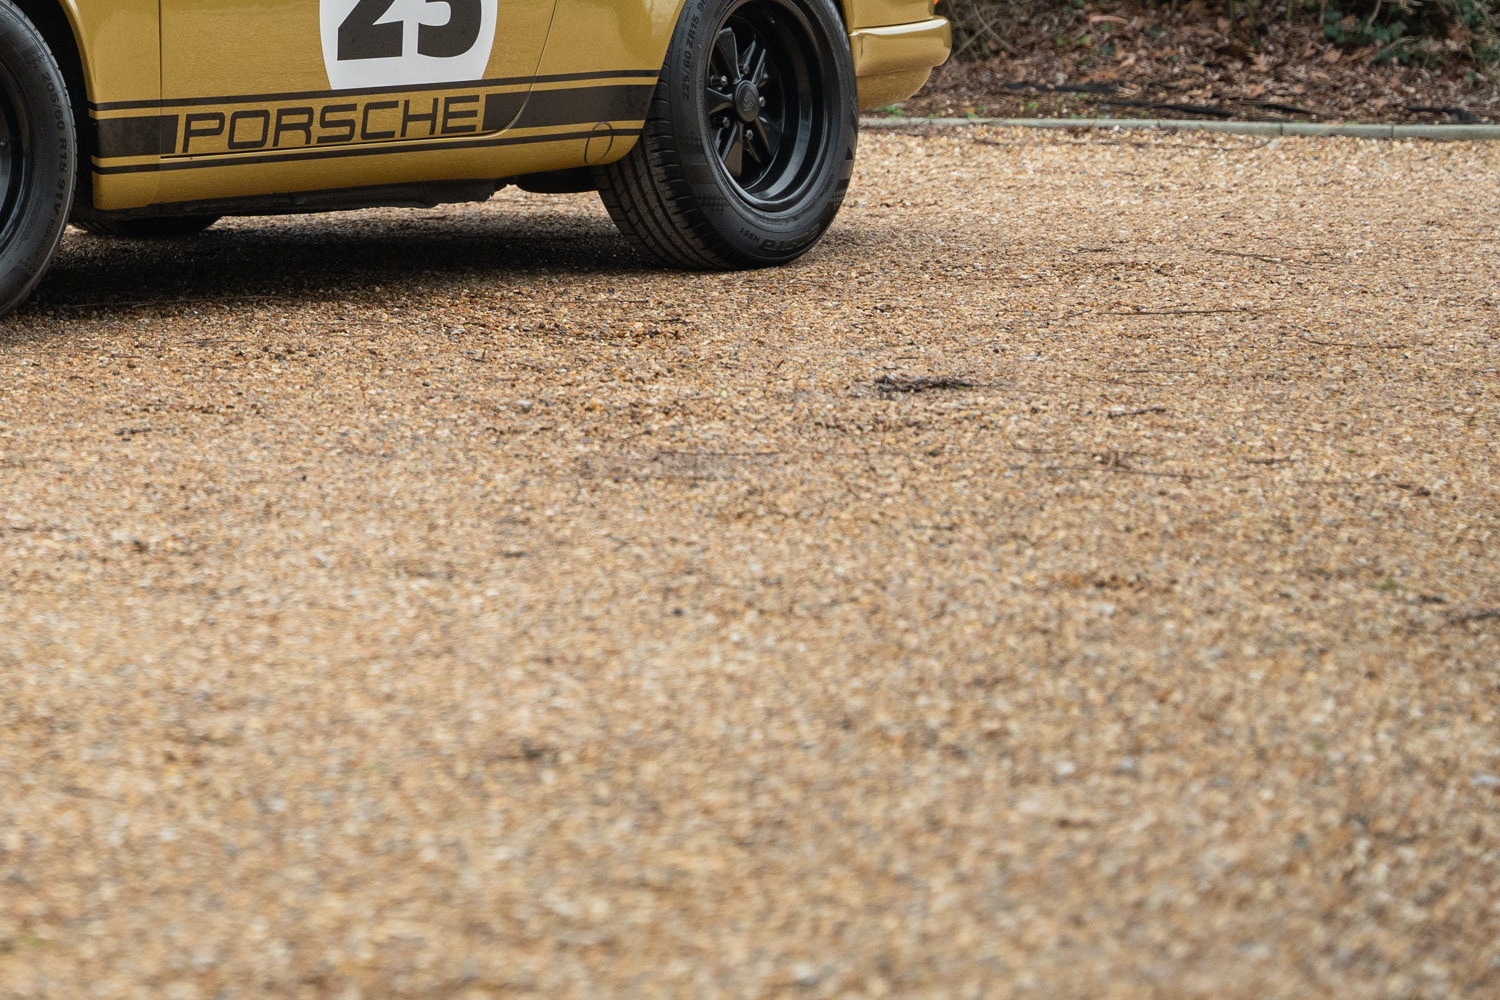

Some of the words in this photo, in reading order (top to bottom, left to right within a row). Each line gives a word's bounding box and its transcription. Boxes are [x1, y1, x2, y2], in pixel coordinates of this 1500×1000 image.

[41, 71, 66, 131] 205/60
[59, 137, 68, 173] R15
[182, 95, 480, 153] PORSCHE
